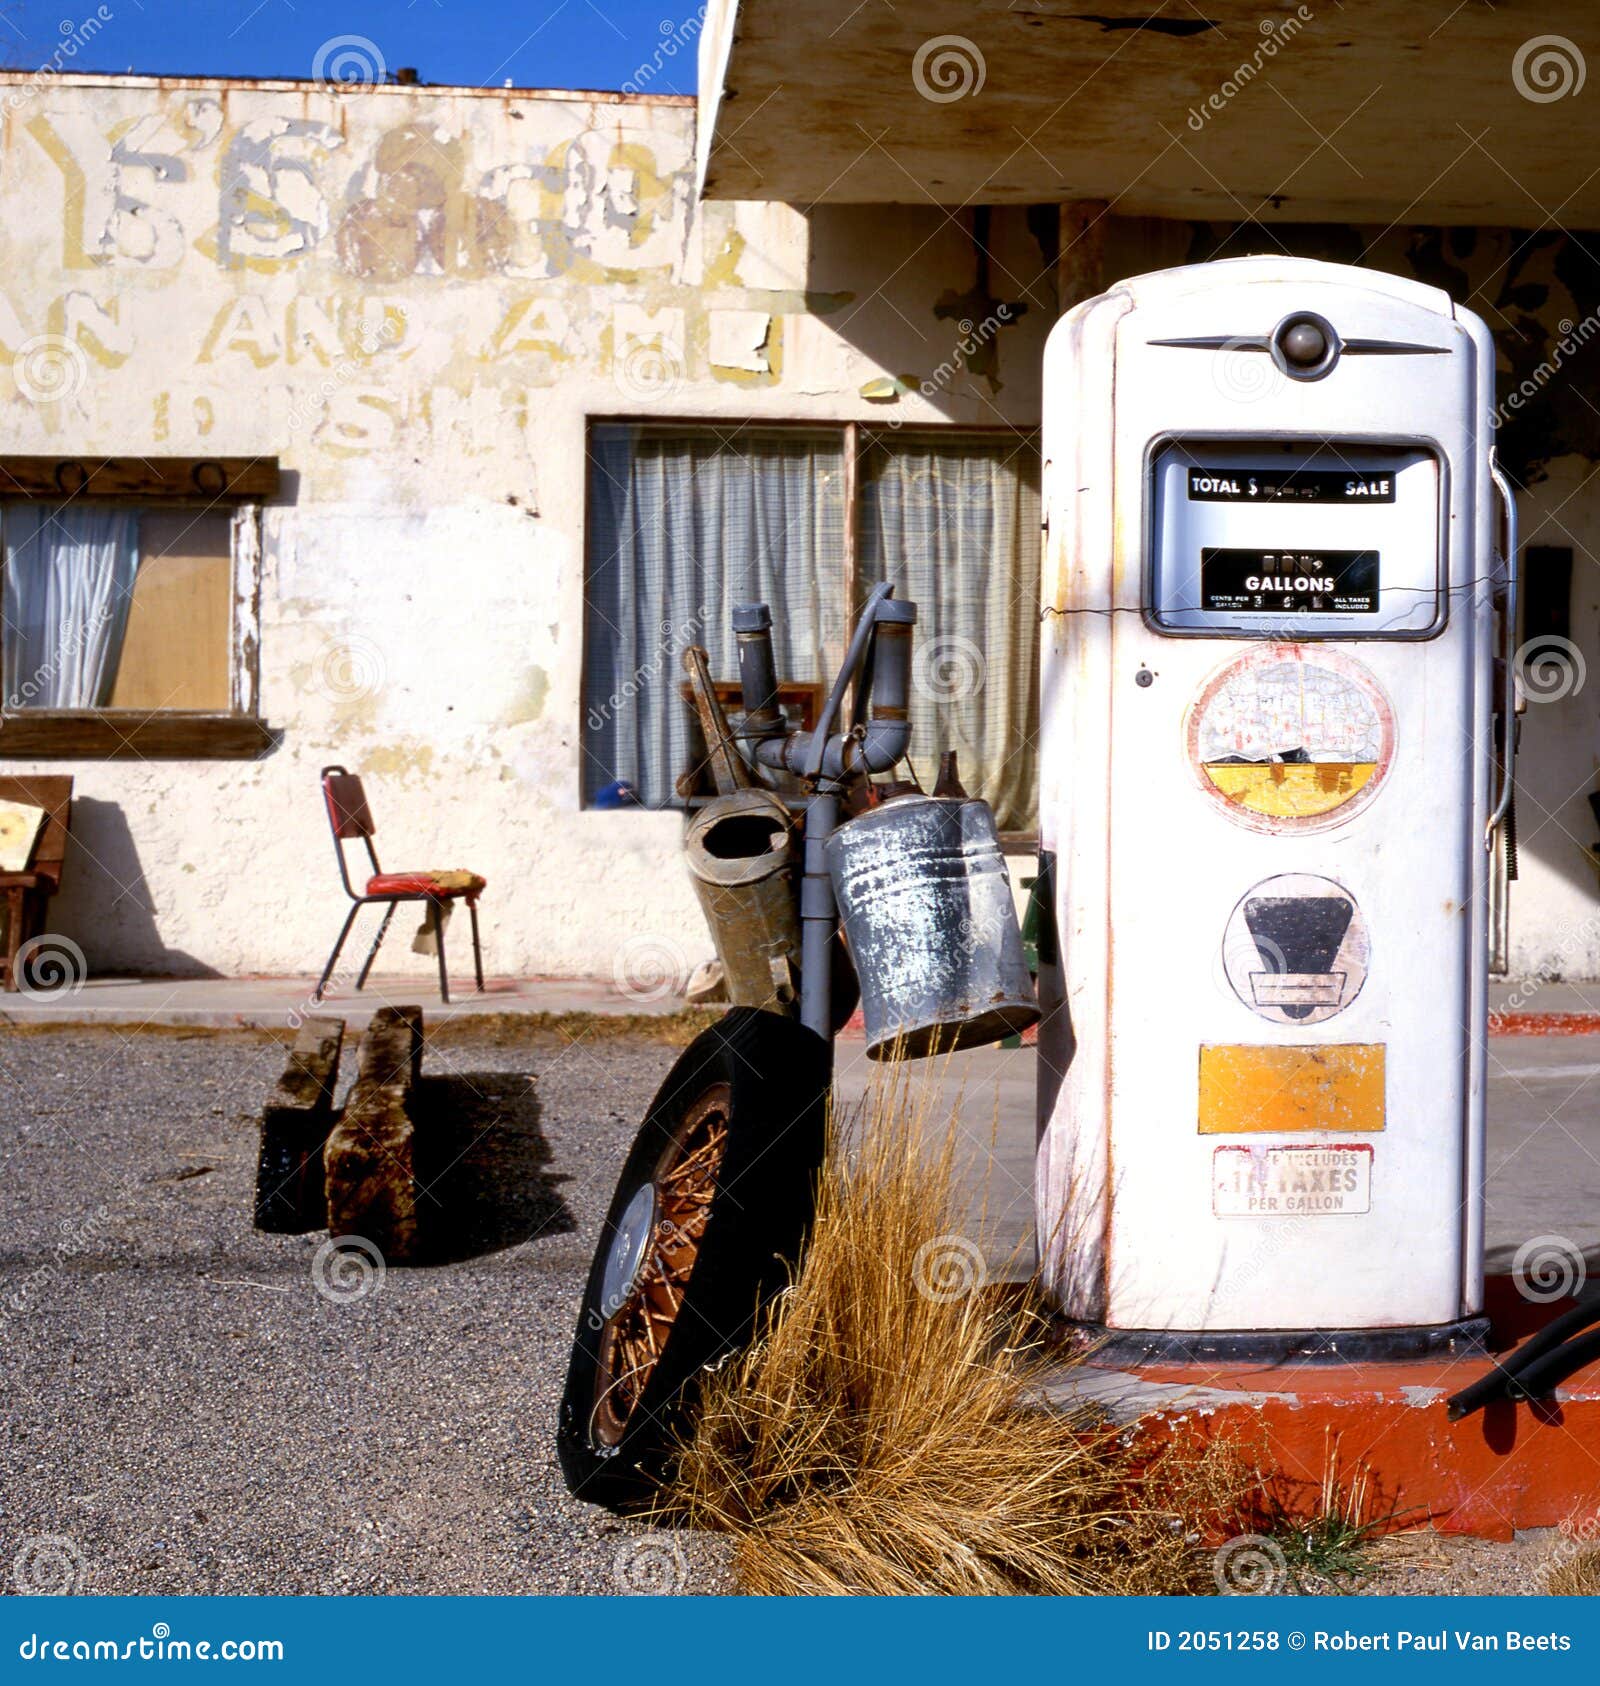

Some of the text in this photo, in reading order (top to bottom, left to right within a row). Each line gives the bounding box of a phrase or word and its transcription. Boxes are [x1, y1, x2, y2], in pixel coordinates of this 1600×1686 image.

[1192, 477, 1241, 494] TOTAL
[1345, 480, 1390, 496] SALE
[1245, 576, 1335, 592] GALLONS
[1248, 1196, 1344, 1211] PER GALLON
